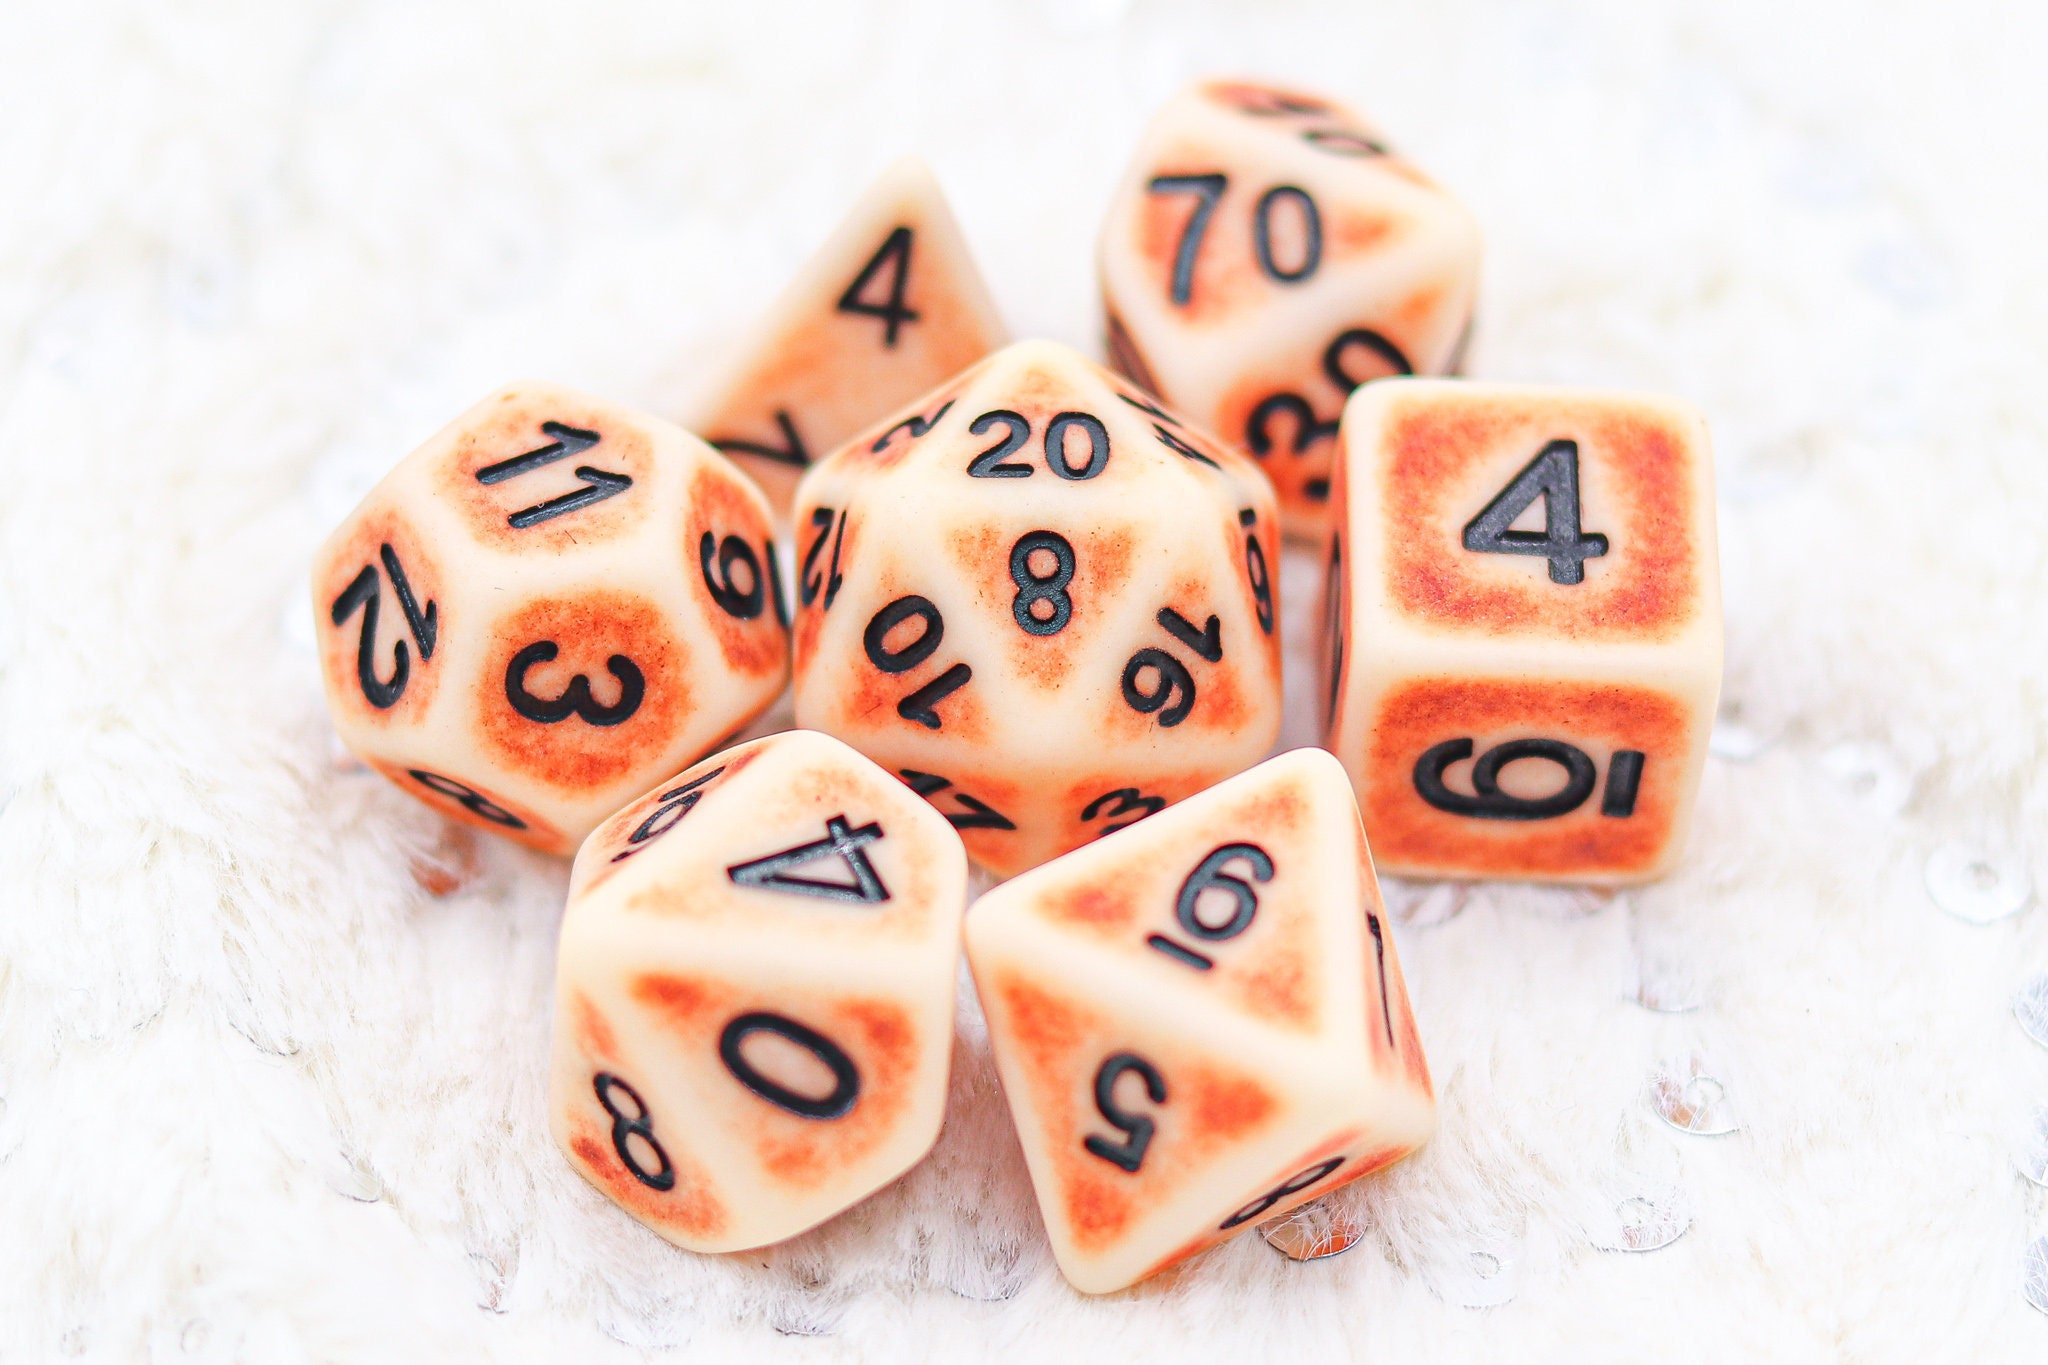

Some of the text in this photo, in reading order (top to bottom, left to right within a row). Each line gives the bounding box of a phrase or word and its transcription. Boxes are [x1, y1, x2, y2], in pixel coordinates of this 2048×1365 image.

[834, 225, 920, 346] 4
[1148, 173, 1324, 305] 70
[477, 420, 633, 529] 11
[967, 409, 1110, 481] 20
[801, 507, 847, 611] 12
[1462, 439, 1609, 585] 4
[331, 542, 437, 709] 12
[1009, 530, 1076, 636] 8
[505, 639, 645, 727] 3
[863, 594, 972, 730] 10
[1120, 606, 1224, 727] 16
[727, 813, 893, 903] 4
[718, 1011, 861, 1121] 0
[1083, 1052, 1168, 1174] 5
[593, 1071, 676, 1191] 8
[1219, 1156, 1347, 1230] 8
